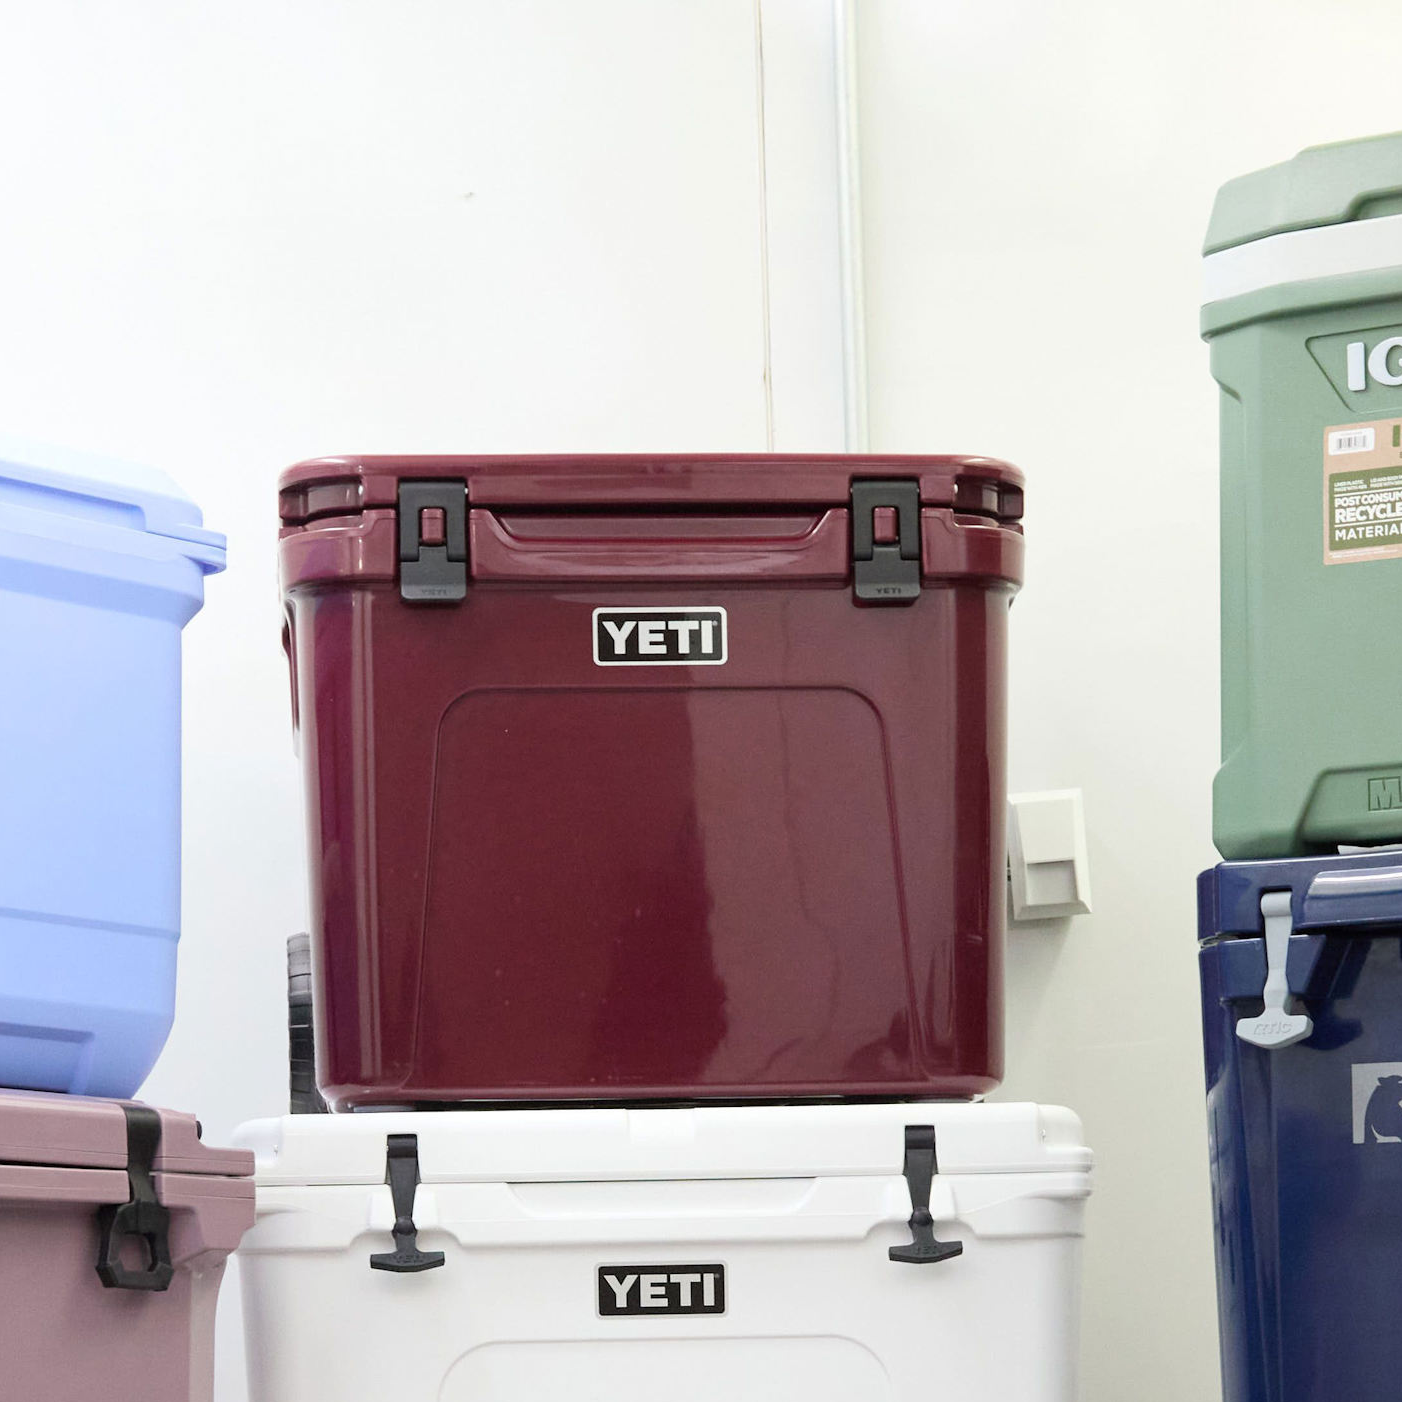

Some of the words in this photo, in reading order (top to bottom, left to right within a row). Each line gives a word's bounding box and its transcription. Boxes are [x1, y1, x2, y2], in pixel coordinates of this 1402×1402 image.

[1334, 495, 1361, 508] POST
[601, 620, 714, 655] YETI
[603, 1273, 715, 1308] YETI
